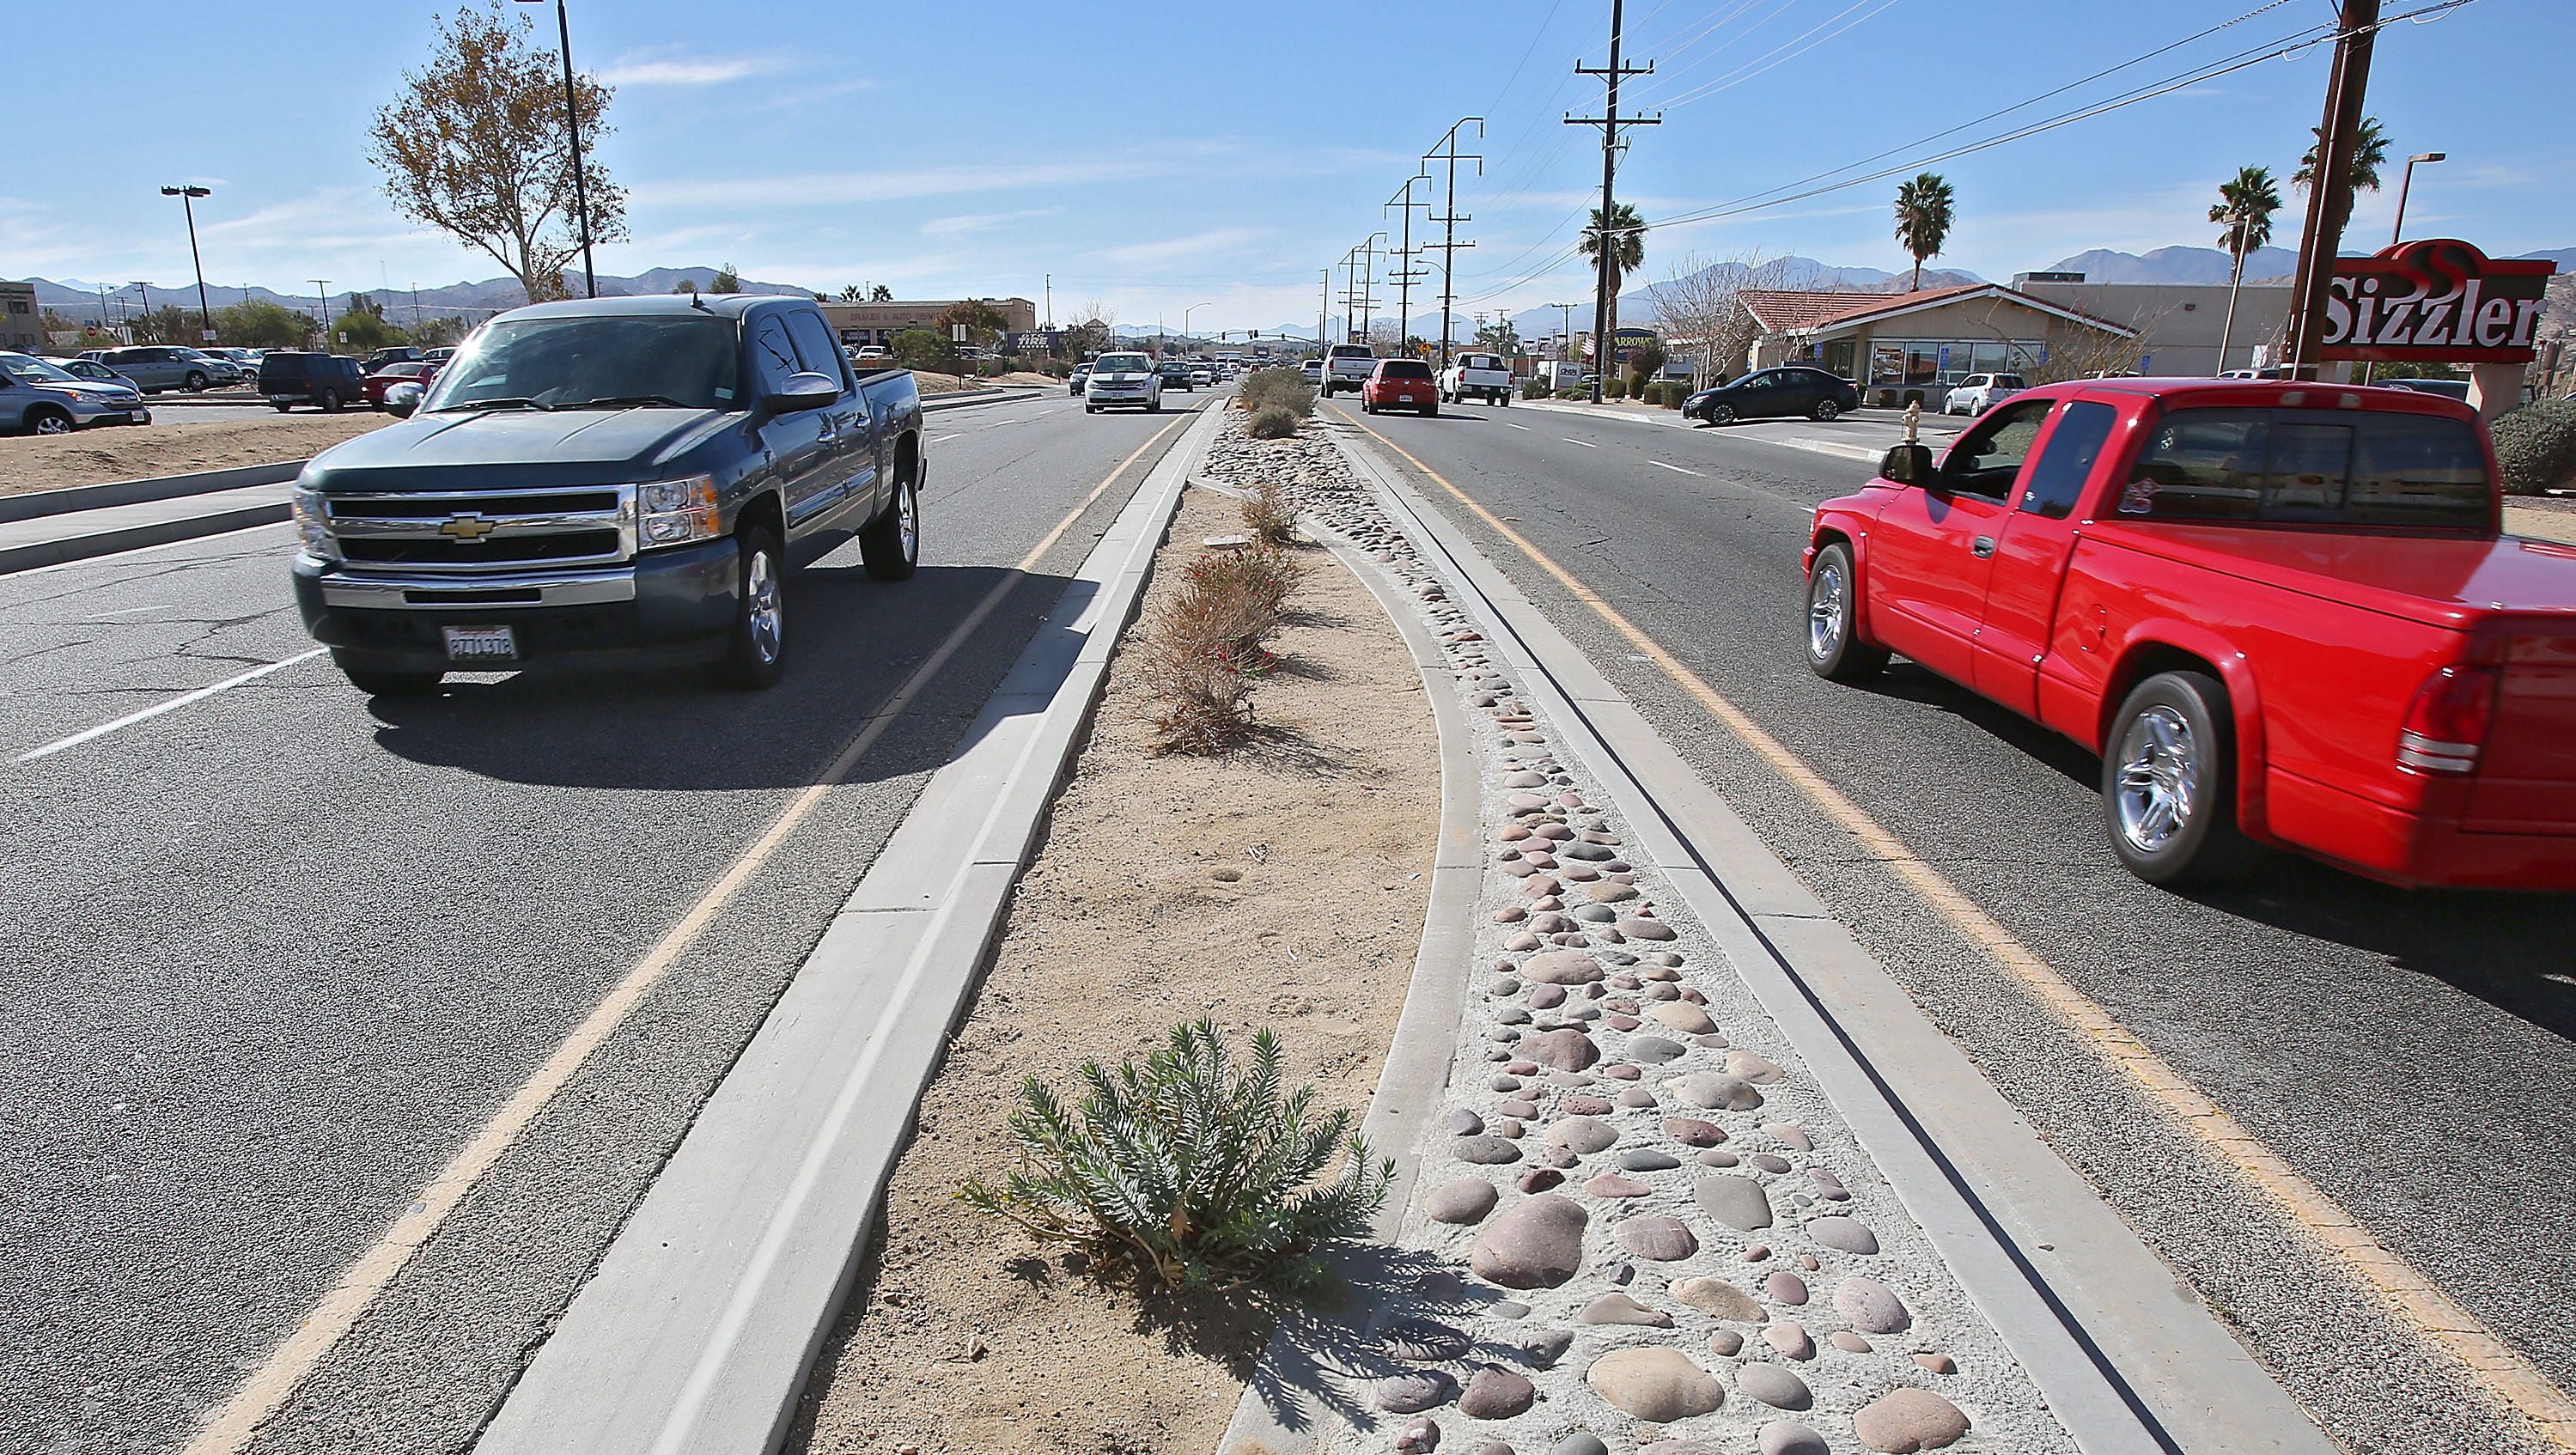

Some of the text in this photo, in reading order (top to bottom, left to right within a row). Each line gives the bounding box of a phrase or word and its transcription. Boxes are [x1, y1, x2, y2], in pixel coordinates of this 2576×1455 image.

[2323, 277, 2549, 347] Sizzler
[1017, 337, 1049, 345] TIRE
[1614, 336, 1654, 347] ARROWS
